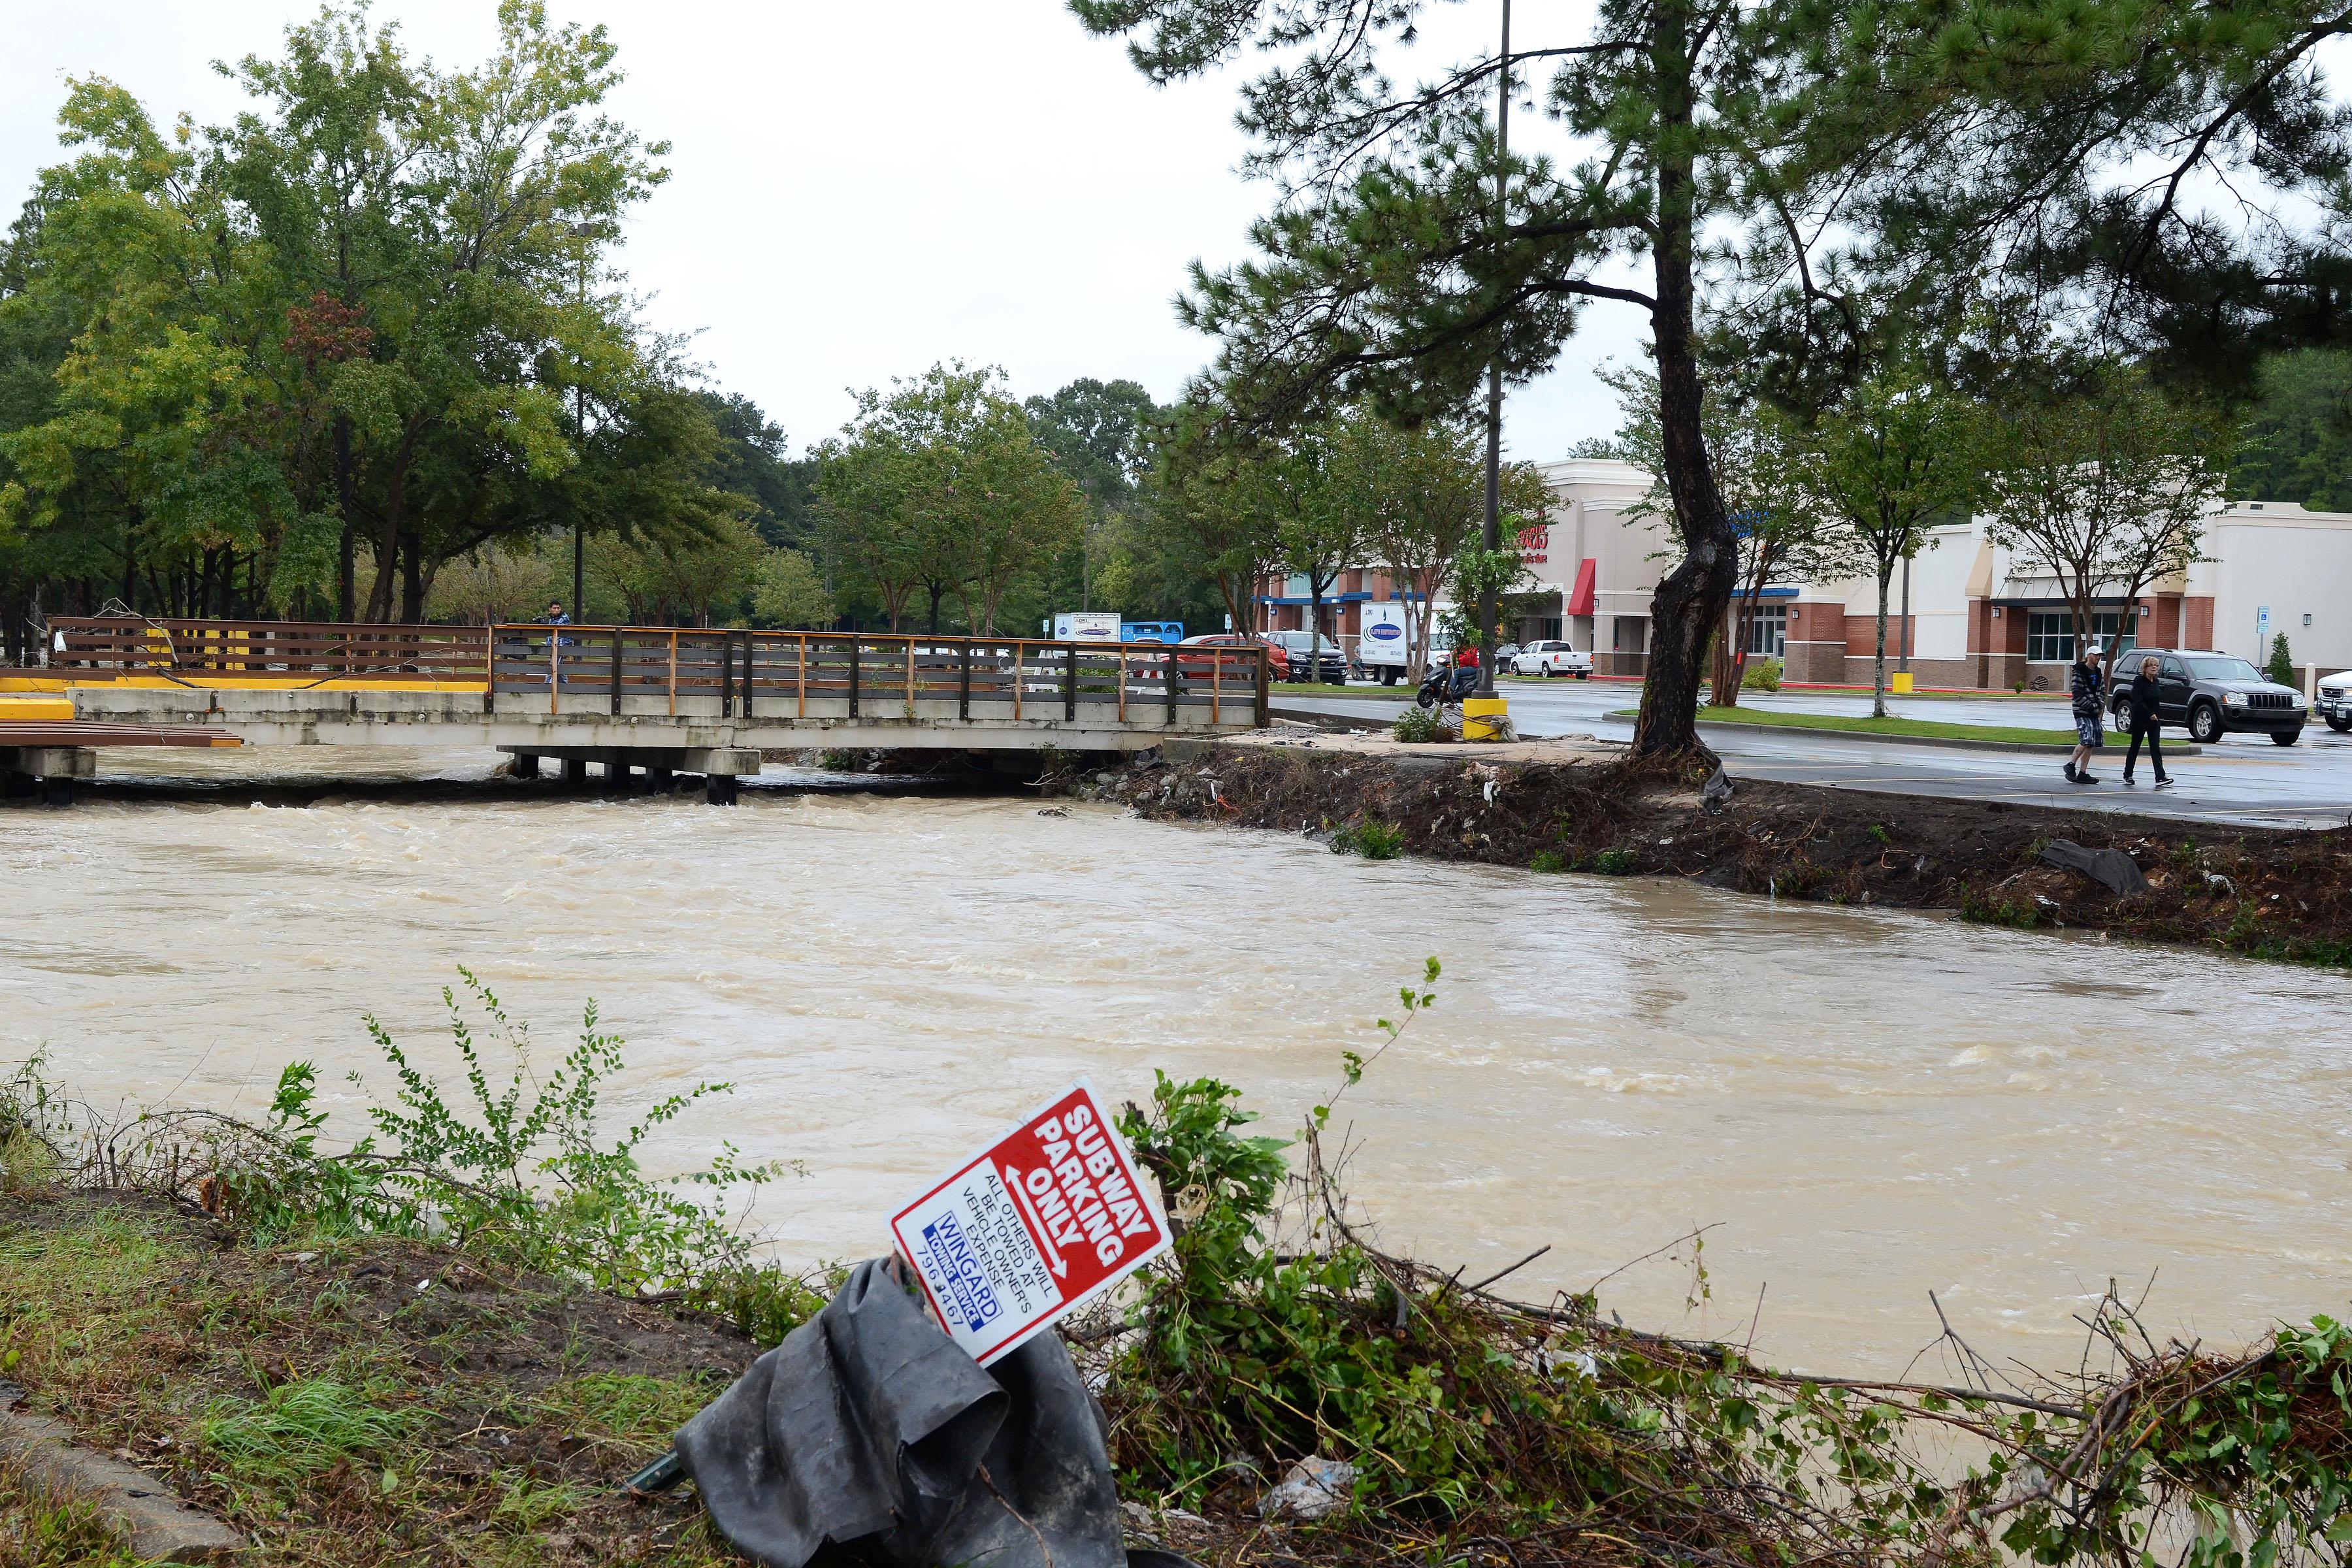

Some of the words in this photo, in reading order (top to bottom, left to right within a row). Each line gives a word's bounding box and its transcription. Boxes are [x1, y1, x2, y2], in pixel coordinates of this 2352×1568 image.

[1026, 1168, 1085, 1248] ONLY
[1034, 1116, 1124, 1267] PARKING
[1064, 1104, 1151, 1238] SUBWAY
[917, 1247, 964, 1325] 7961467
[927, 1232, 957, 1279] TOWING
[949, 1278, 981, 1324] SERVICE
[939, 1215, 998, 1318] WINGARD
[963, 1186, 998, 1247] VEHICLE
[994, 1249, 1032, 1313] OWNER'S
[966, 1224, 1005, 1290] EXPENSE
[981, 1194, 997, 1216] BE
[994, 1216, 1024, 1268] TOWED
[1020, 1273, 1036, 1289] AT
[985, 1175, 1002, 1201] ALL
[1002, 1203, 1036, 1260] OTHERS
[1032, 1261, 1053, 1298] WILL
